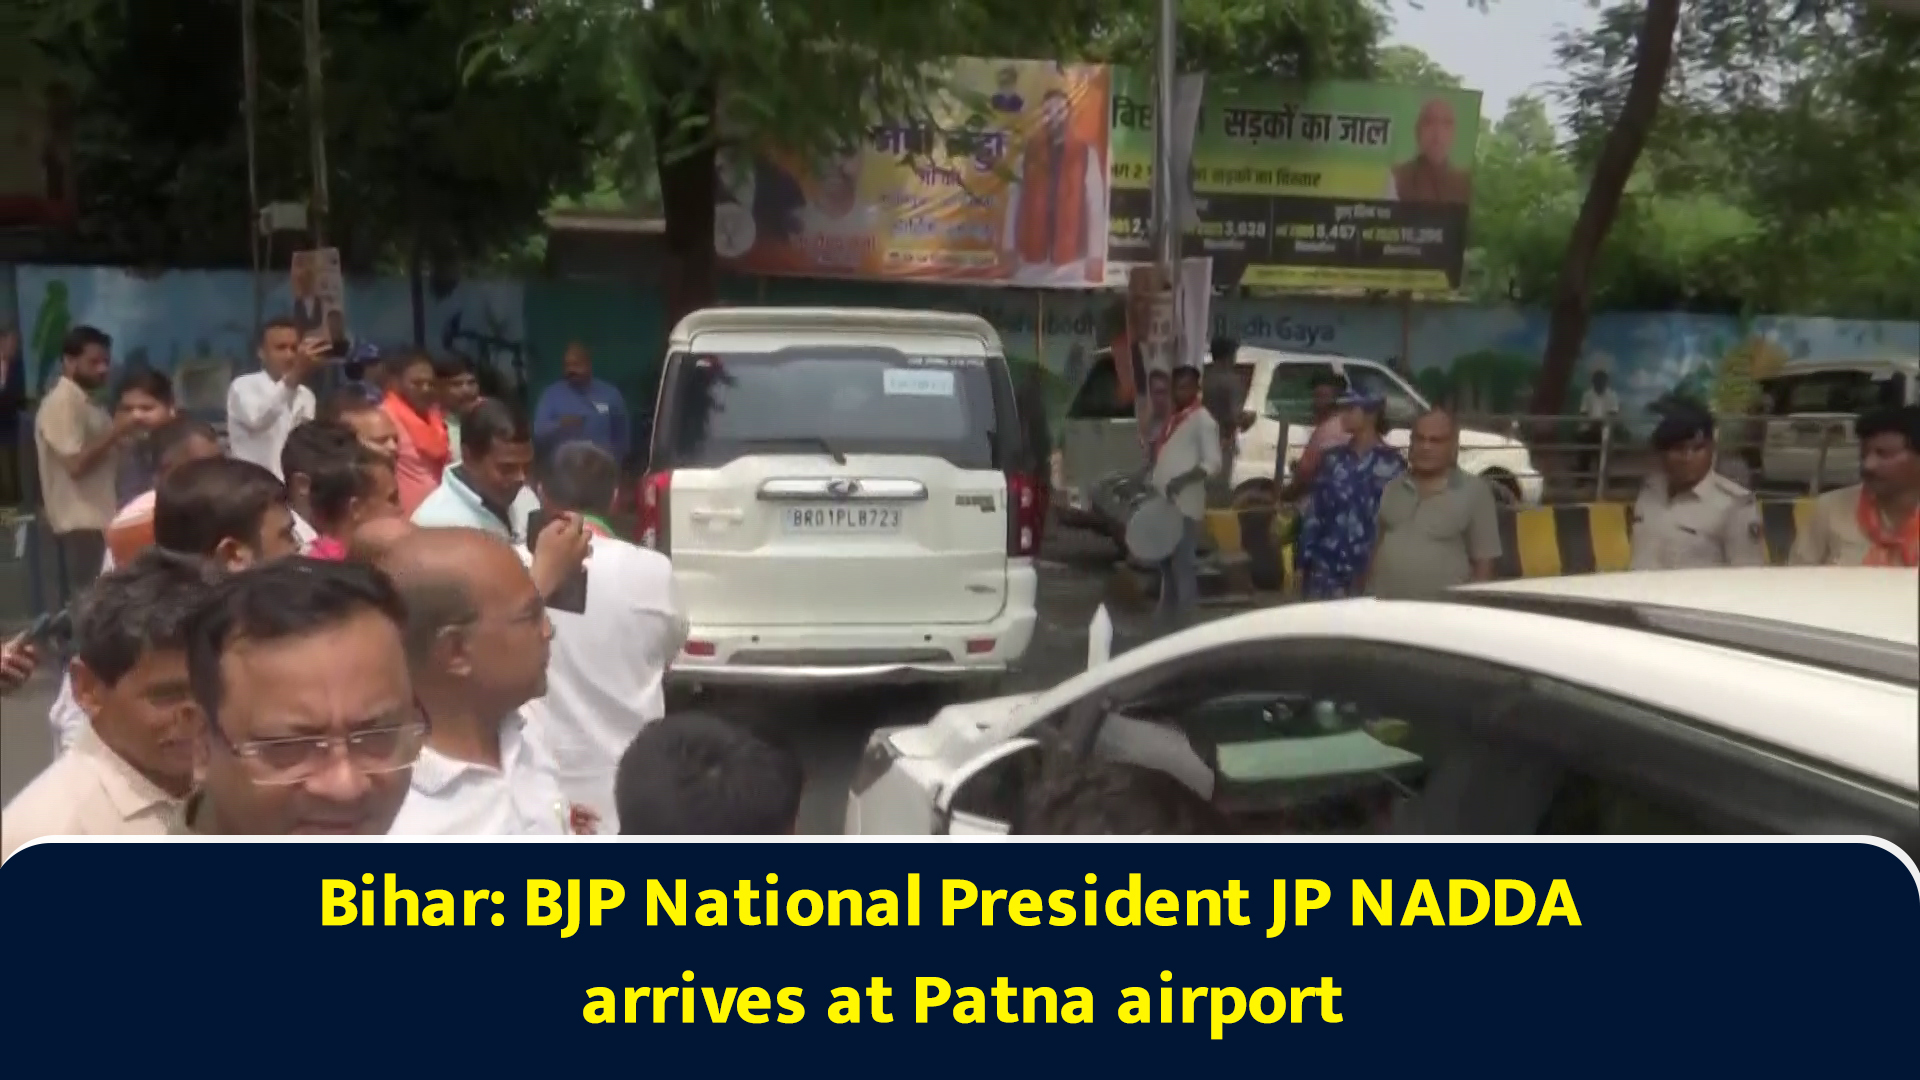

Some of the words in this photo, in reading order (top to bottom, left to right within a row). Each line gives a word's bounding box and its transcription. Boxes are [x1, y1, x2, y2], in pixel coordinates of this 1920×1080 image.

[1224, 104, 1297, 145] सड़कों
[1301, 111, 1331, 142] का
[1337, 114, 1391, 146] जाल
[1277, 316, 1335, 348] Gaya
